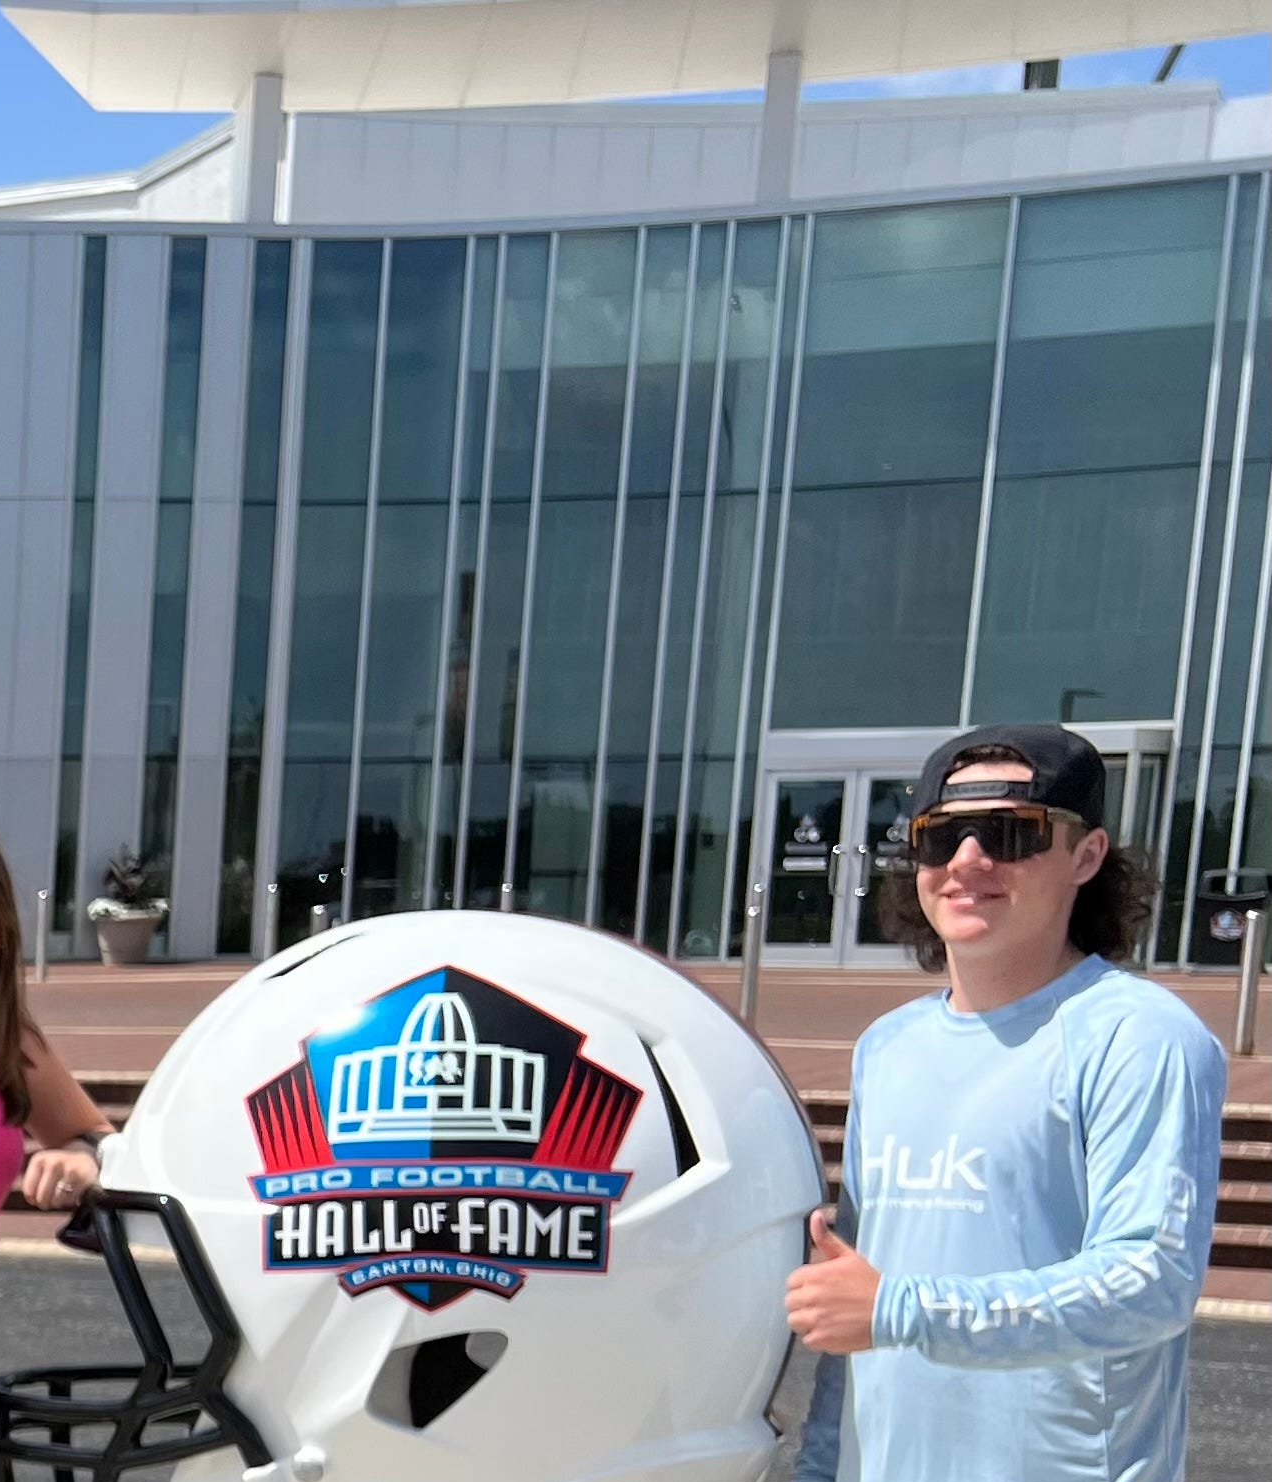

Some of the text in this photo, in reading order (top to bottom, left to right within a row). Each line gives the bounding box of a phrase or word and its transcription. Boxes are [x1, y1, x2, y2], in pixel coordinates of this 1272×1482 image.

[265, 1167, 610, 1197] PRO FOOTBALL
[274, 1198, 596, 1259] HALL OF FAME
[456, 1262, 511, 1287] OHIO
